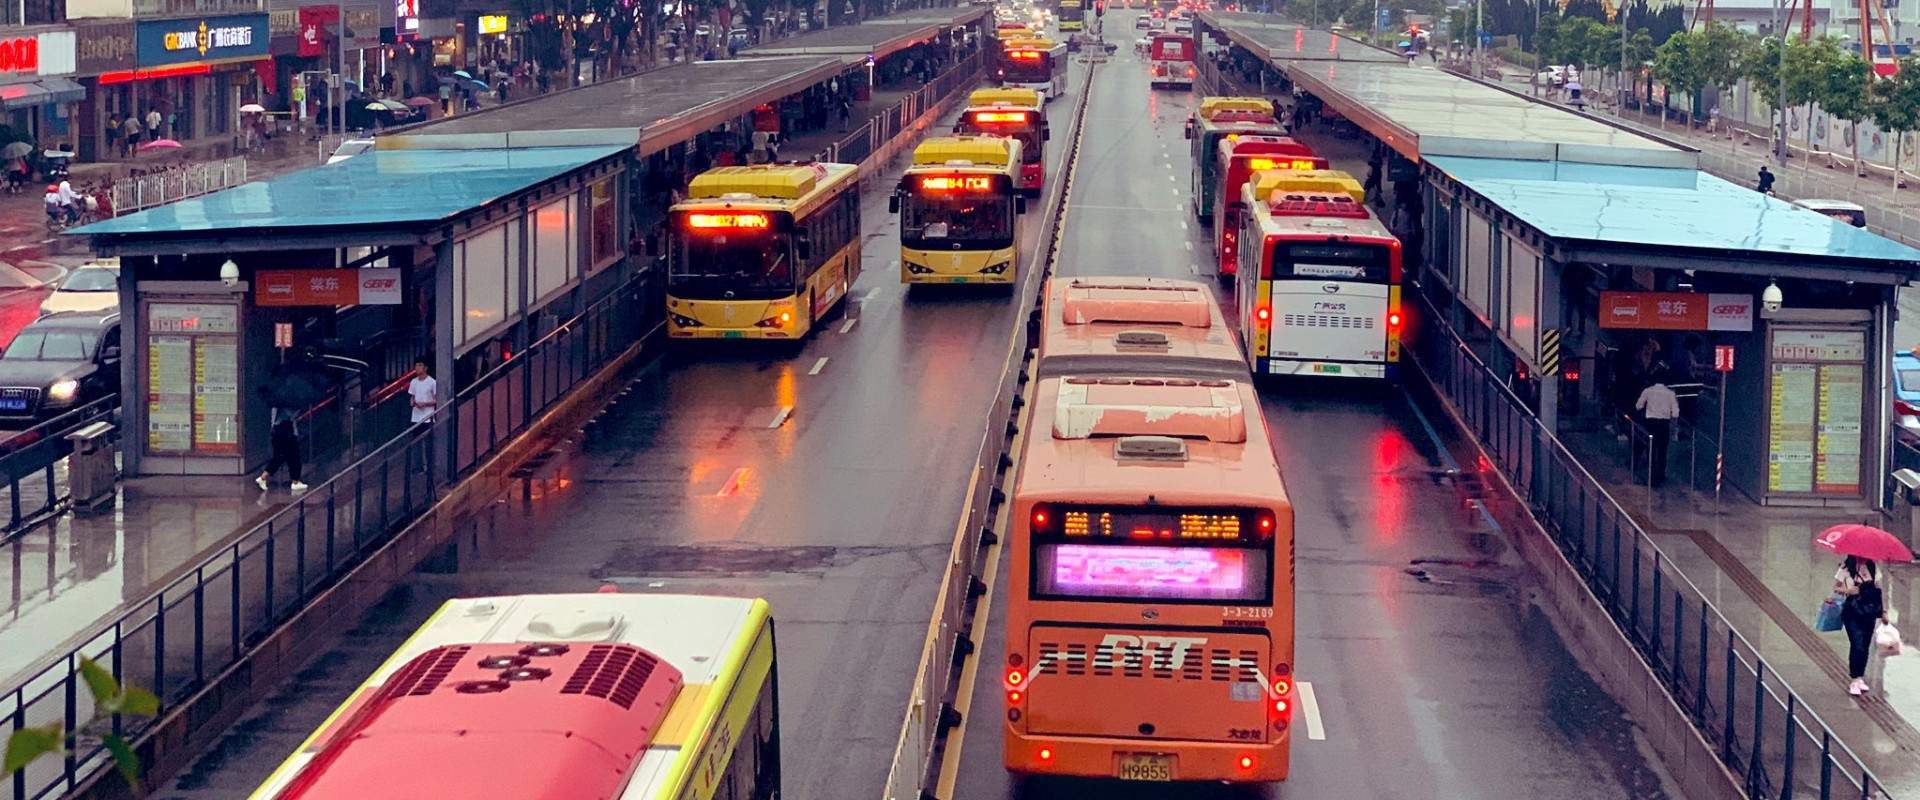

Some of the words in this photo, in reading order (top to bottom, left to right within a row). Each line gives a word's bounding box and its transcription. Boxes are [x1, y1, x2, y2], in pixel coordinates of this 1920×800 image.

[1657, 301, 1687, 315] 棠东
[1222, 606, 1274, 618] 3-3-2109
[1092, 633, 1209, 670] BRT
[1122, 763, 1168, 780] H9855
